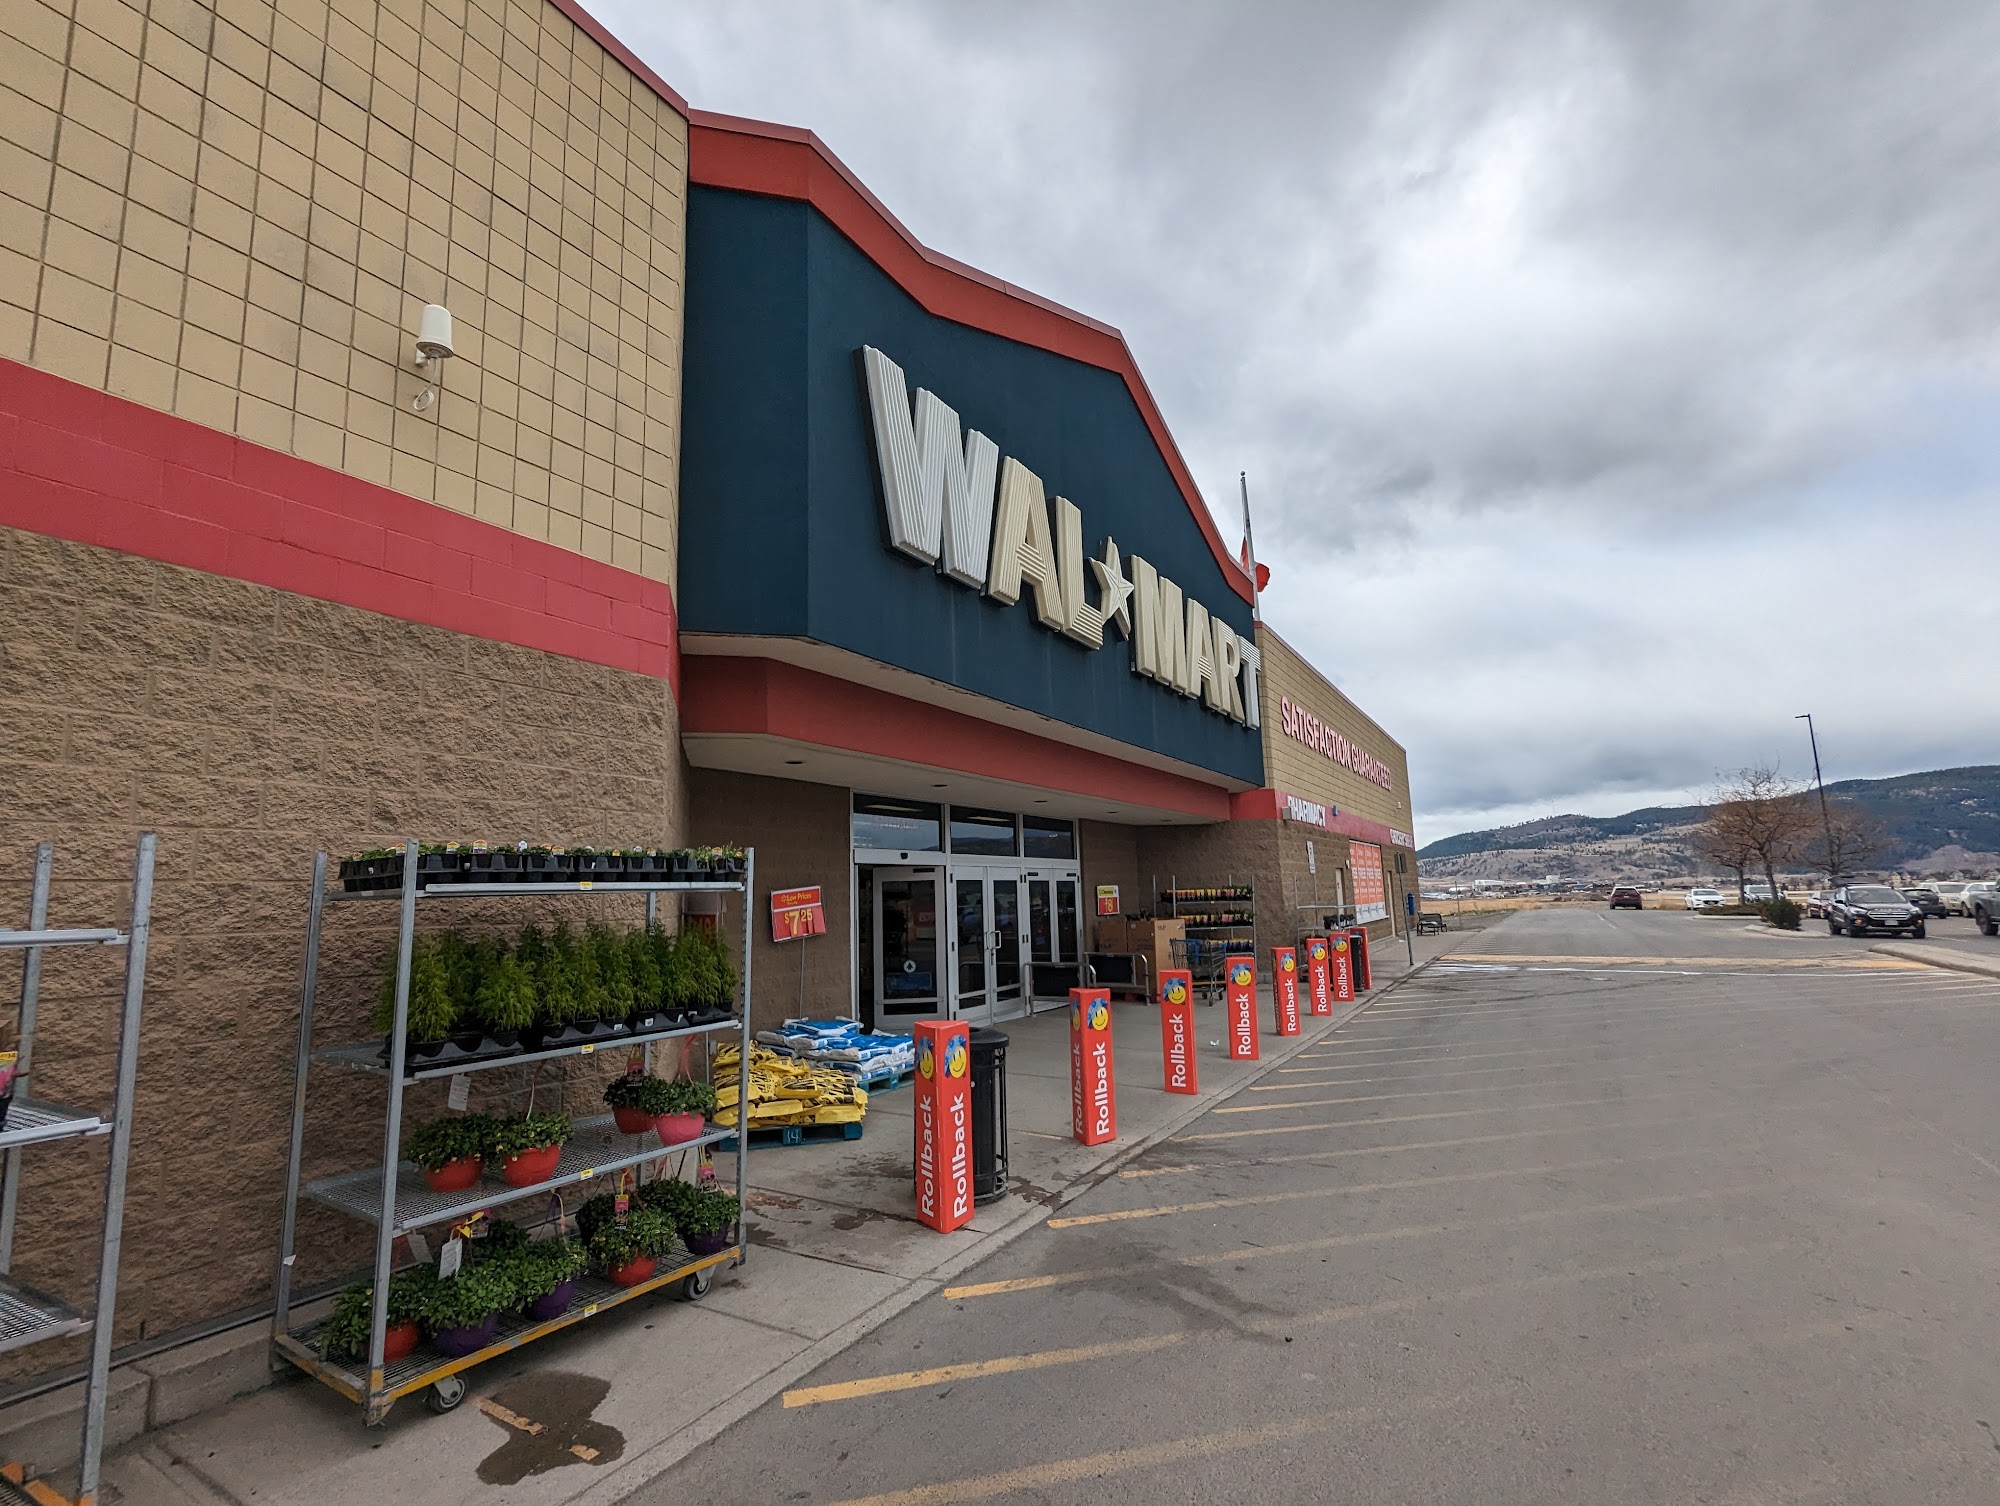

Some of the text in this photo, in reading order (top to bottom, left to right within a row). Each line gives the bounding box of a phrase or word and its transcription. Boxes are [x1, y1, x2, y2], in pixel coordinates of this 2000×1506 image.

[863, 344, 1261, 730] WAL MART
[1281, 696, 1391, 791] SATISFACTION GUARANTEED
[1288, 796, 1325, 827] PHARMACY
[1285, 978, 1297, 1032] Rollback
[1315, 965, 1327, 1012] Rollback
[1337, 957, 1349, 998] Rollback
[1169, 1013, 1187, 1088] Rollback
[1235, 993, 1252, 1055] Rollback
[1073, 1043, 1083, 1134] Rollback
[1093, 1041, 1110, 1136] Rollback
[919, 1094, 934, 1217] Rollback
[950, 1092, 968, 1218] Rollback
